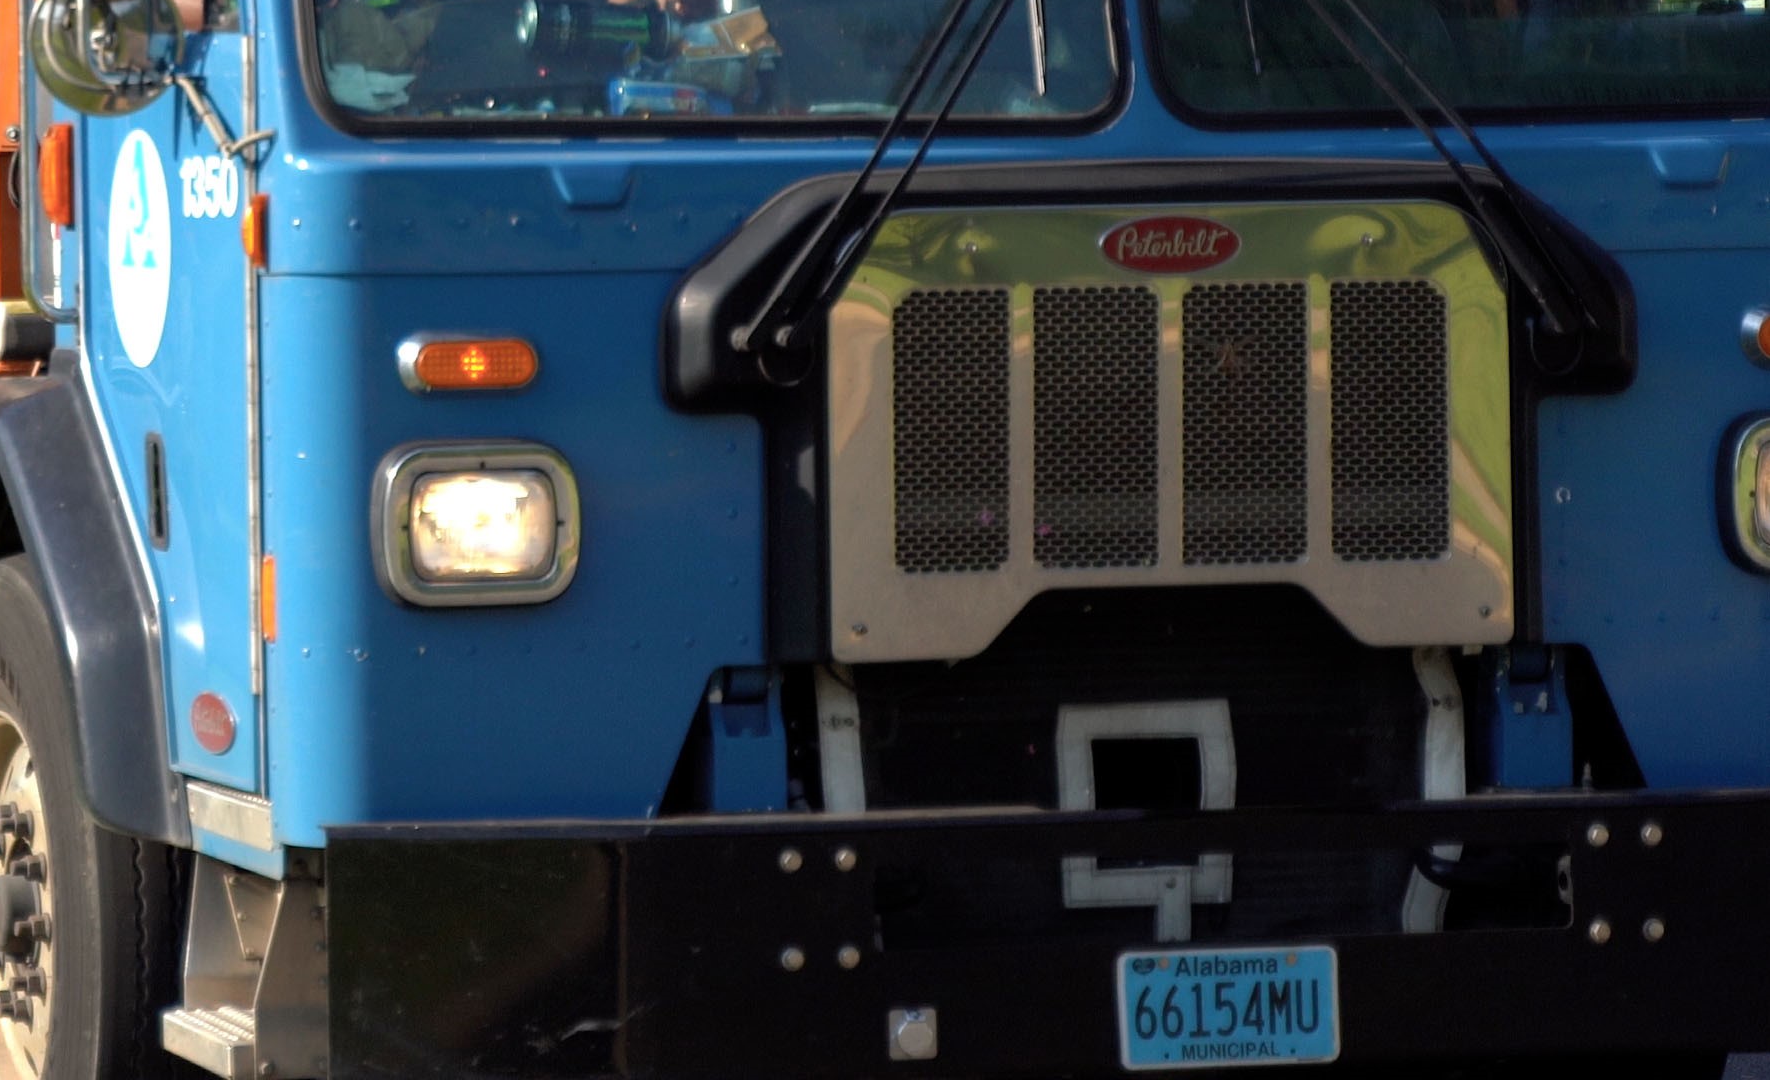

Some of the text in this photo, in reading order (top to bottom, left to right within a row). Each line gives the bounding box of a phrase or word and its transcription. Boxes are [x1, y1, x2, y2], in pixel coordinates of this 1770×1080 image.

[179, 155, 239, 219] 1350
[1117, 226, 1229, 261] Peterbilt
[1175, 956, 1278, 977] Alabama
[1135, 978, 1319, 1041] 66154MU
[1181, 1042, 1280, 1061] MUNICIPAL
